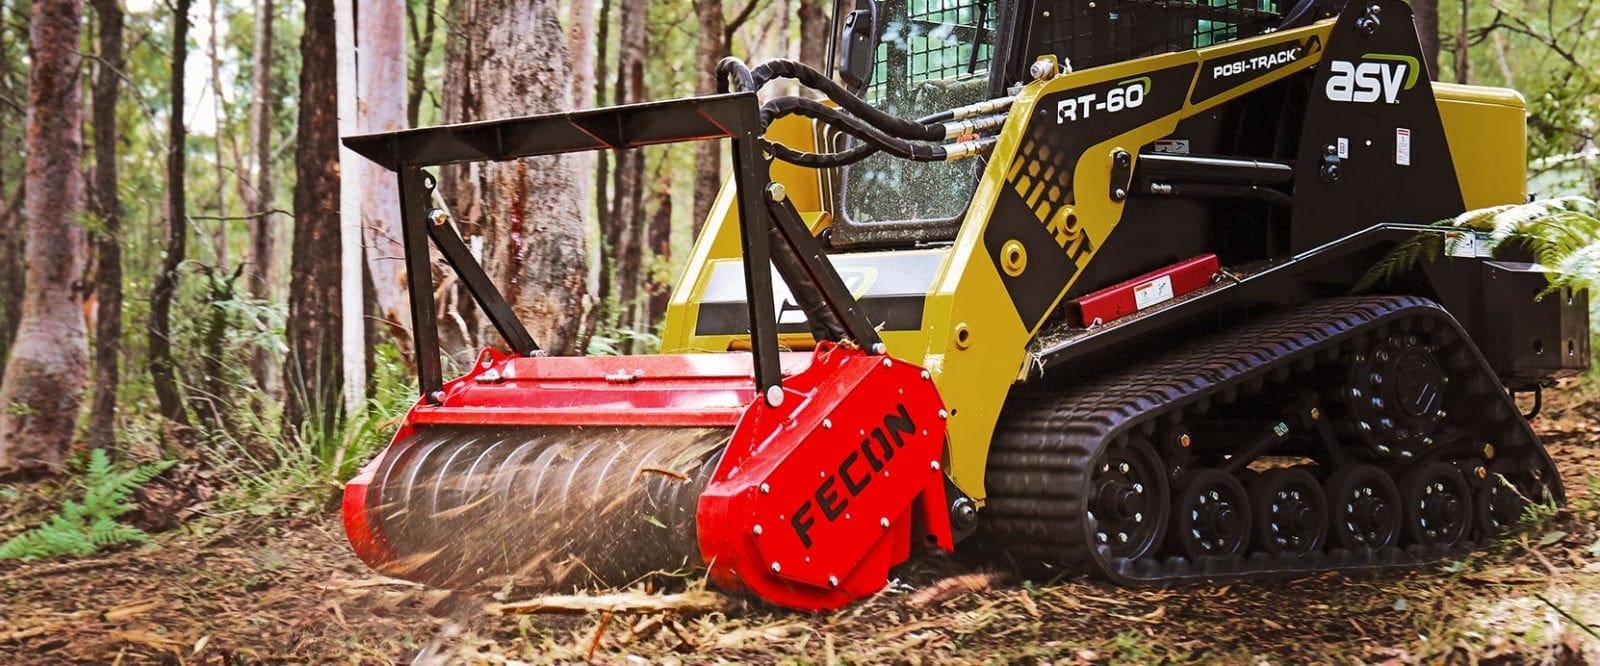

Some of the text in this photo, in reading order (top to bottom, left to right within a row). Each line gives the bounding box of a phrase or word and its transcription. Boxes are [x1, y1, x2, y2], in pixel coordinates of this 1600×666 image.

[1213, 48, 1298, 79] POSI-TRACK
[1057, 83, 1144, 124] RT-60
[791, 403, 917, 549] FECON
